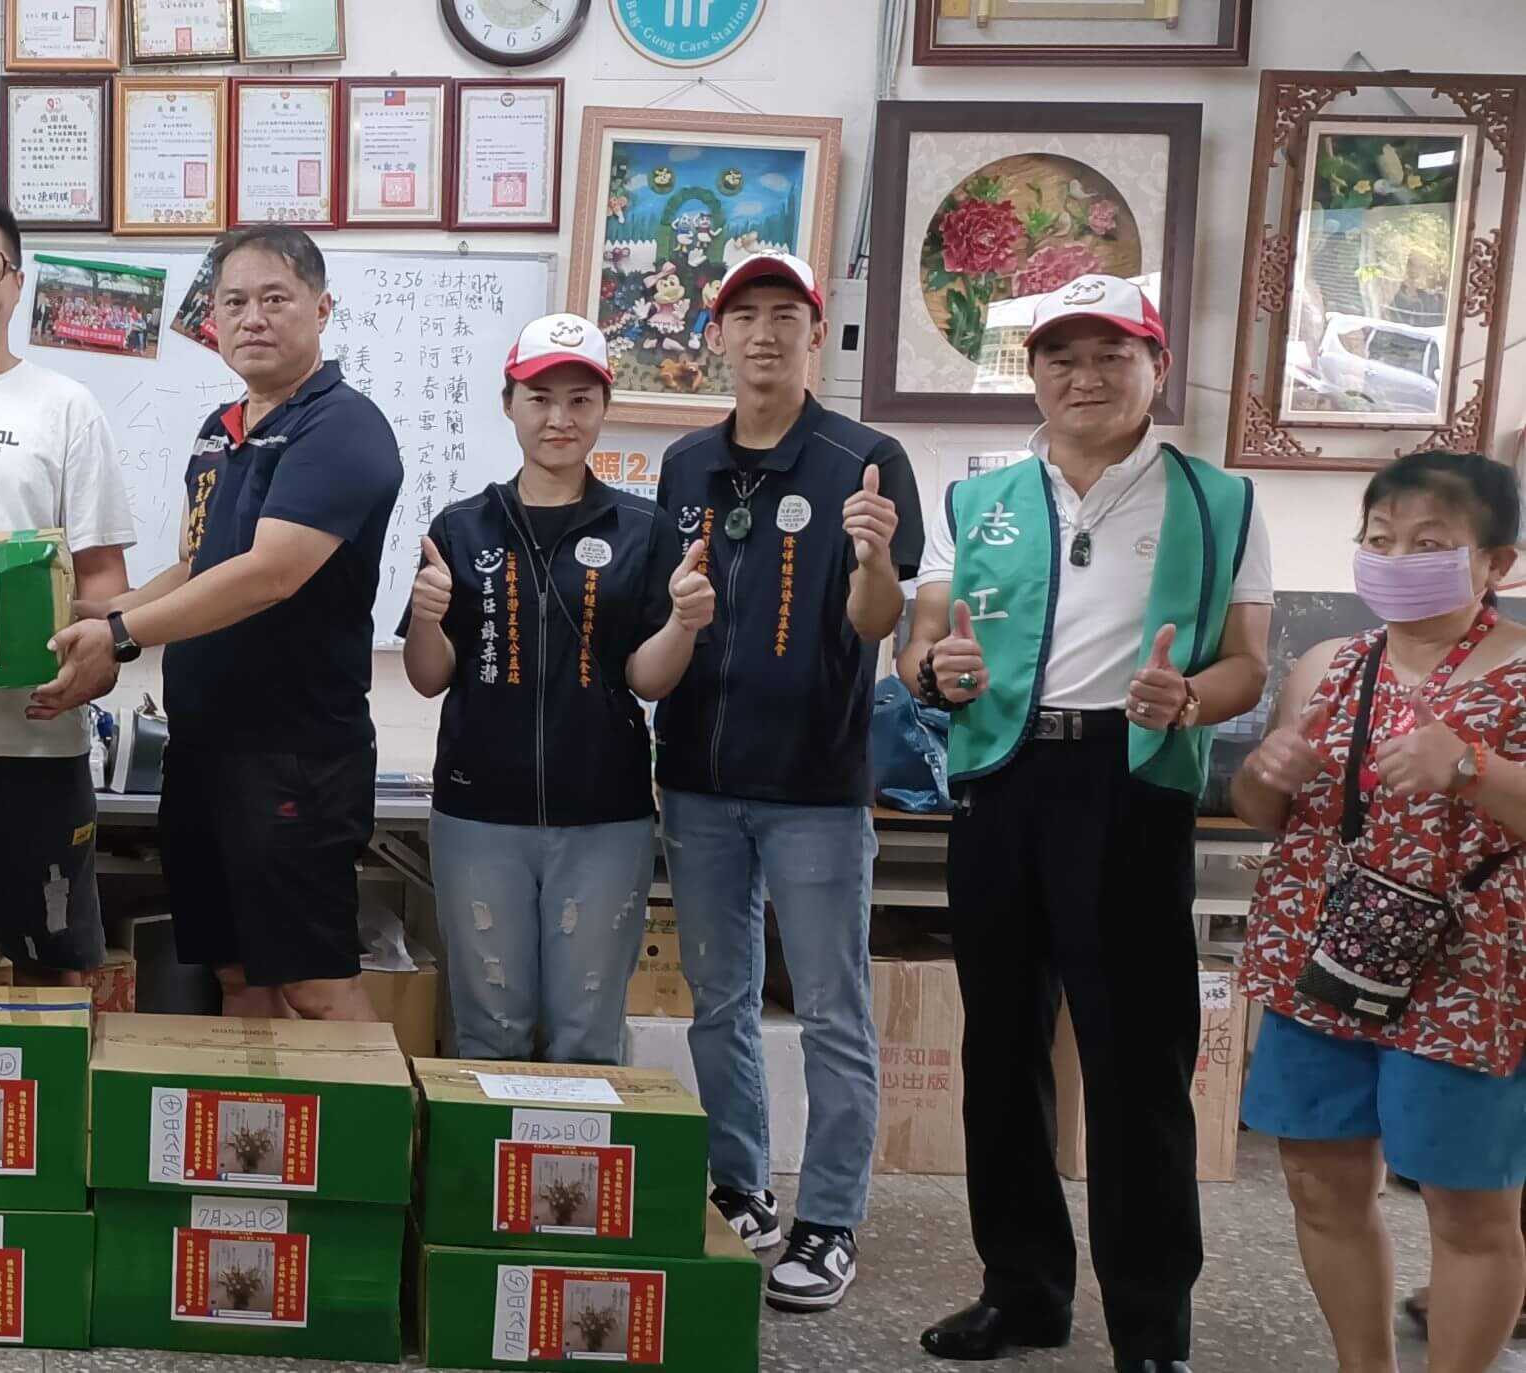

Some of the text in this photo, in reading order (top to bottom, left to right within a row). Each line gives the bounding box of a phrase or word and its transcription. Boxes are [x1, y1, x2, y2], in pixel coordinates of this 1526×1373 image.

[464, 5, 475, 20] 8
[482, 24, 493, 40] 7
[530, 26, 543, 41] 5
[679, 38, 710, 53] Care
[711, 1, 751, 45] Station
[506, 31, 517, 48] 6
[419, 313, 474, 337] 阿森
[419, 345, 474, 368] 阿彩
[421, 373, 470, 405] 春蘭
[968, 501, 1021, 622] 志工
[482, 577, 497, 614] 主任
